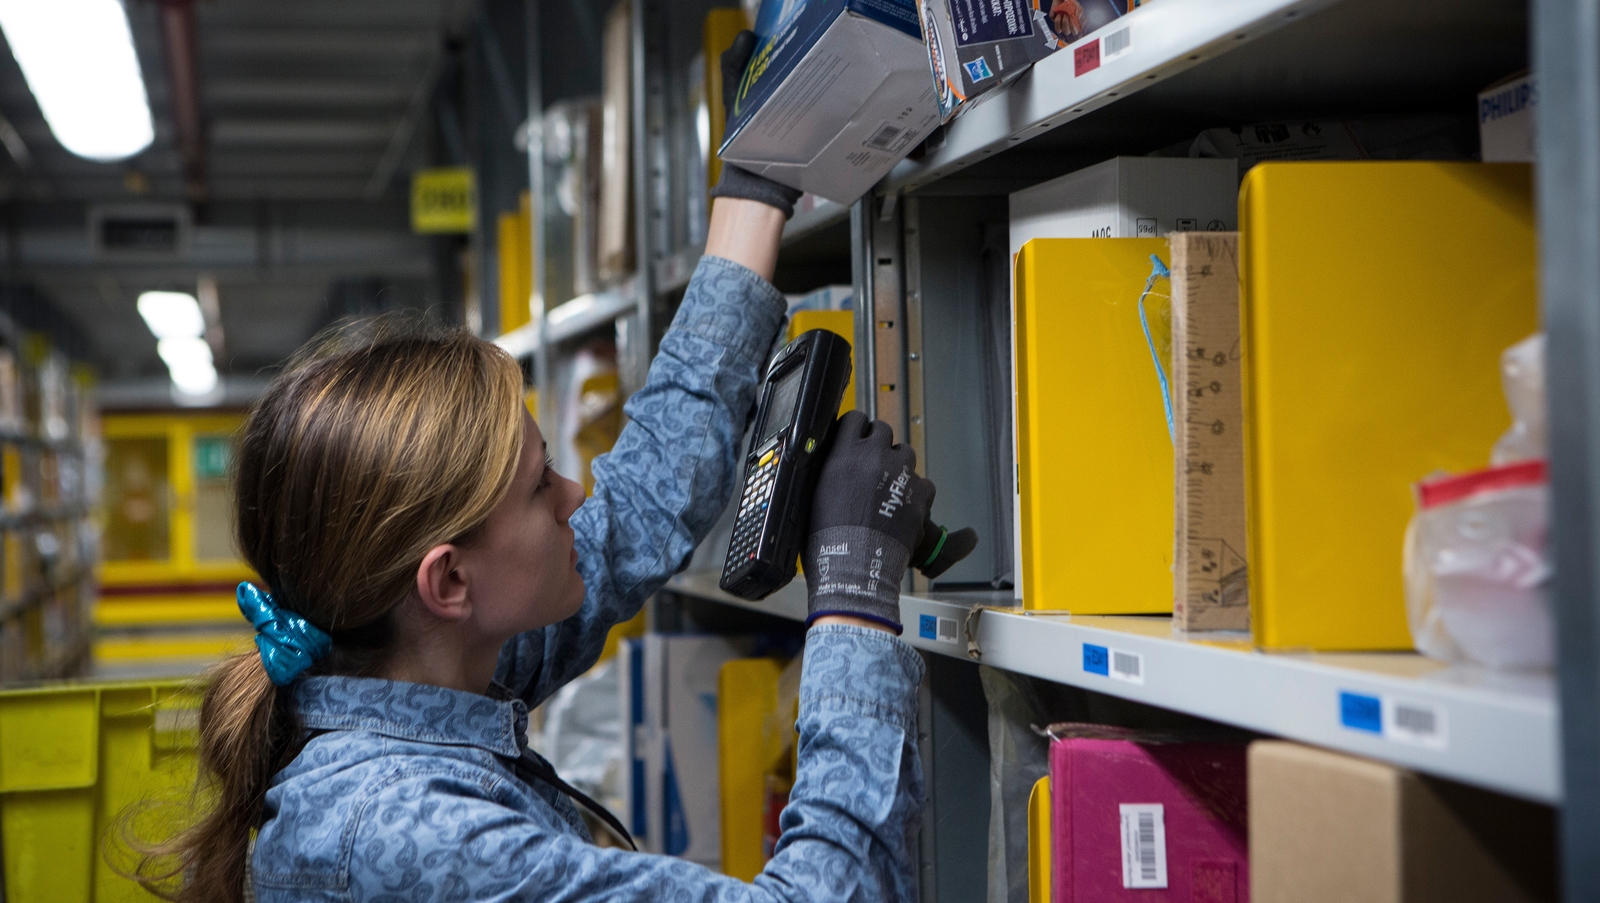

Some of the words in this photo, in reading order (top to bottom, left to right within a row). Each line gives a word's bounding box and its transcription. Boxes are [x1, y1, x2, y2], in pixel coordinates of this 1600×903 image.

[1138, 224, 1156, 233] IP65
[878, 469, 911, 519] HyFlex
[819, 542, 849, 554] Ansell
[818, 583, 830, 591] Made
[837, 582, 845, 590] Sri
